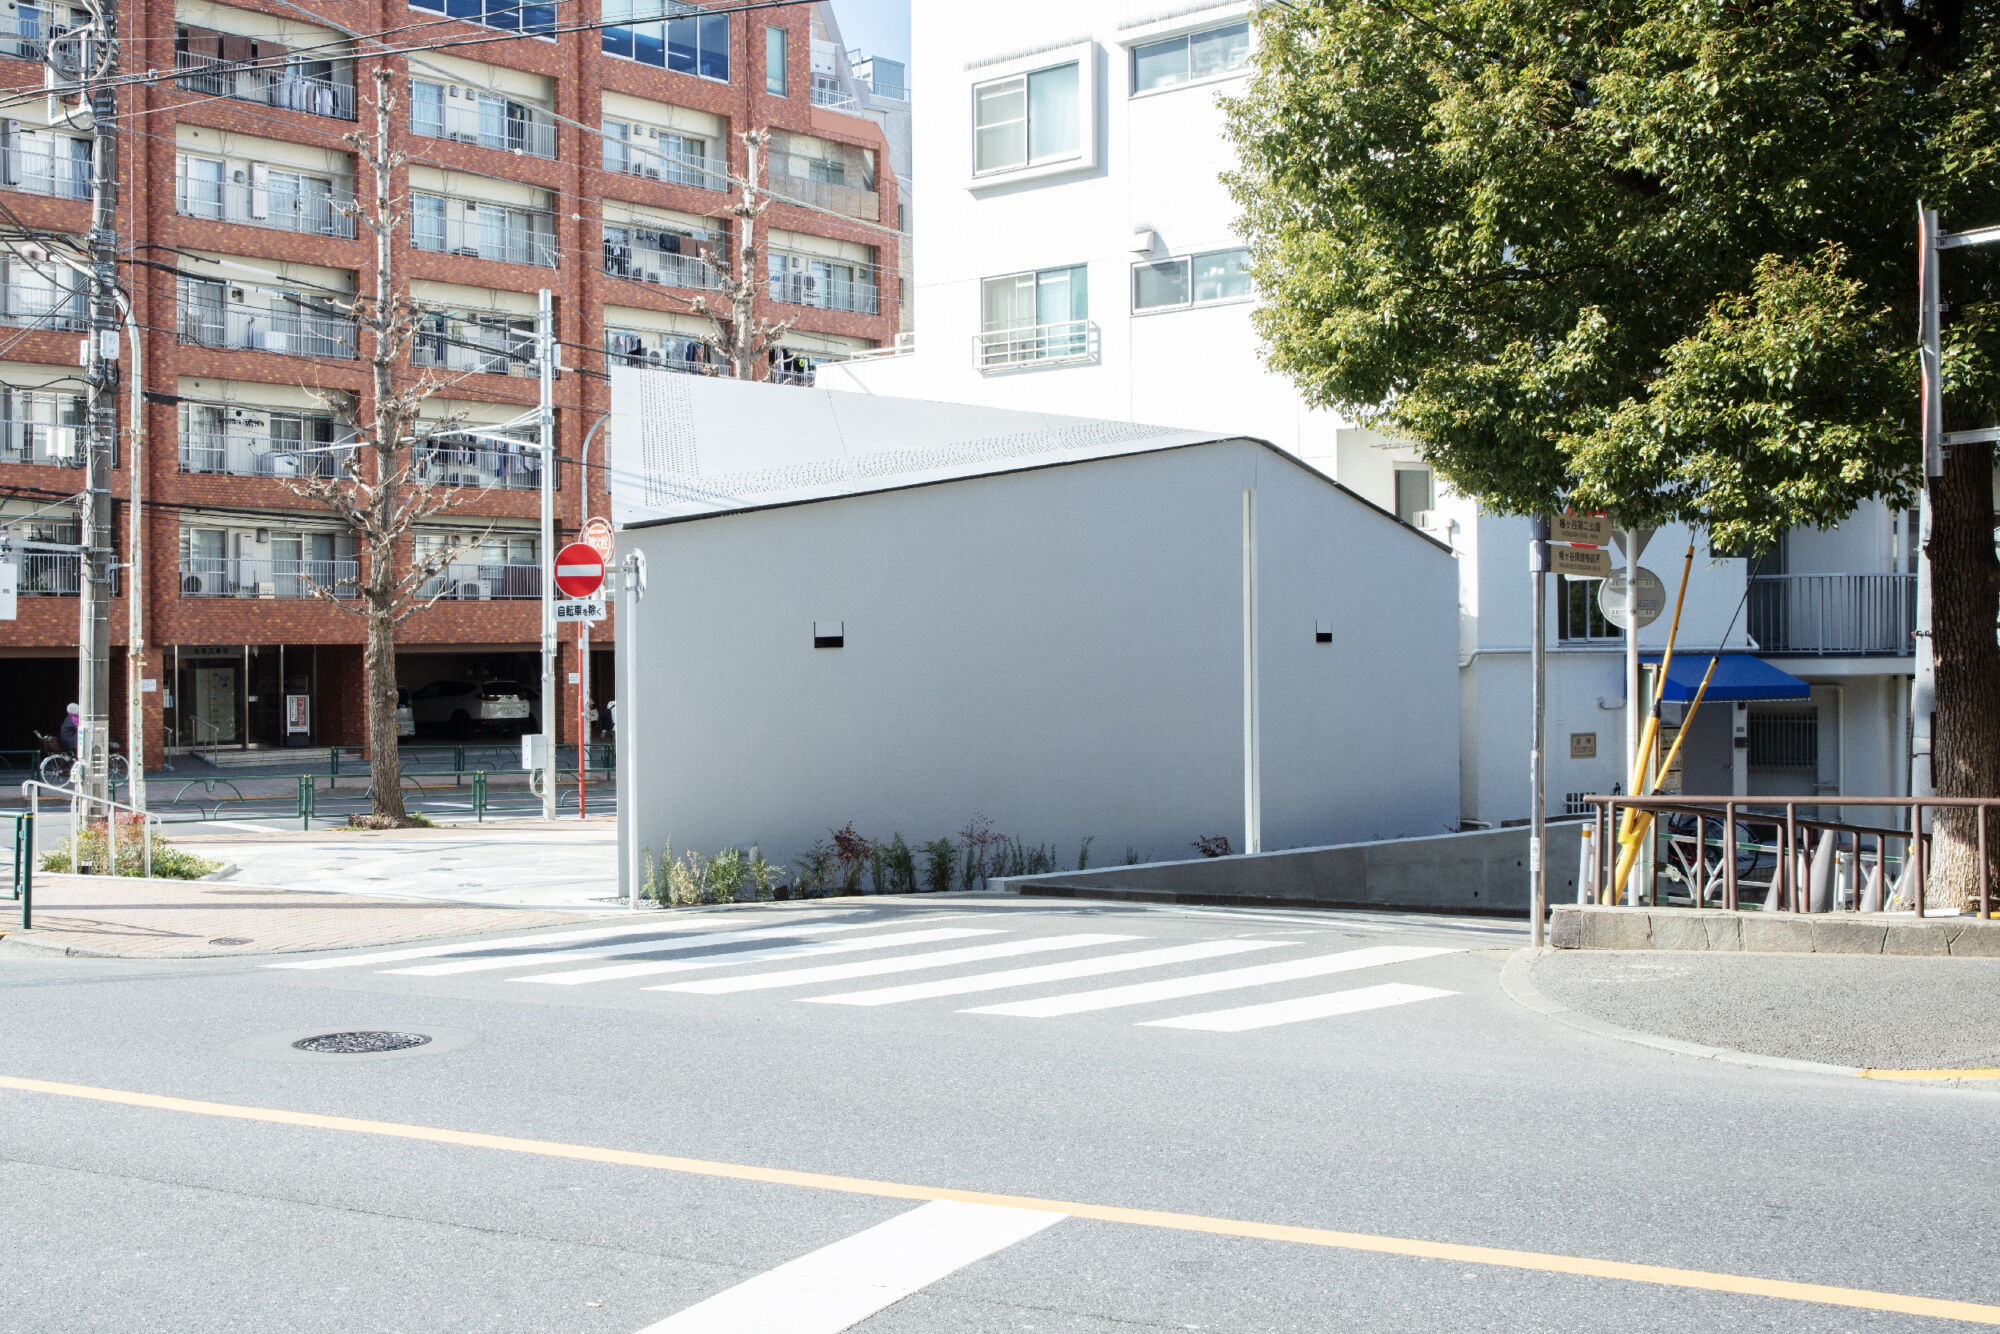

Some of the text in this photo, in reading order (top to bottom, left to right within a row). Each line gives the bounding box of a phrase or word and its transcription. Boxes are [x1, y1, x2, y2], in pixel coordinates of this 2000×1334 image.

[557, 605, 602, 617] 自転車を除く
